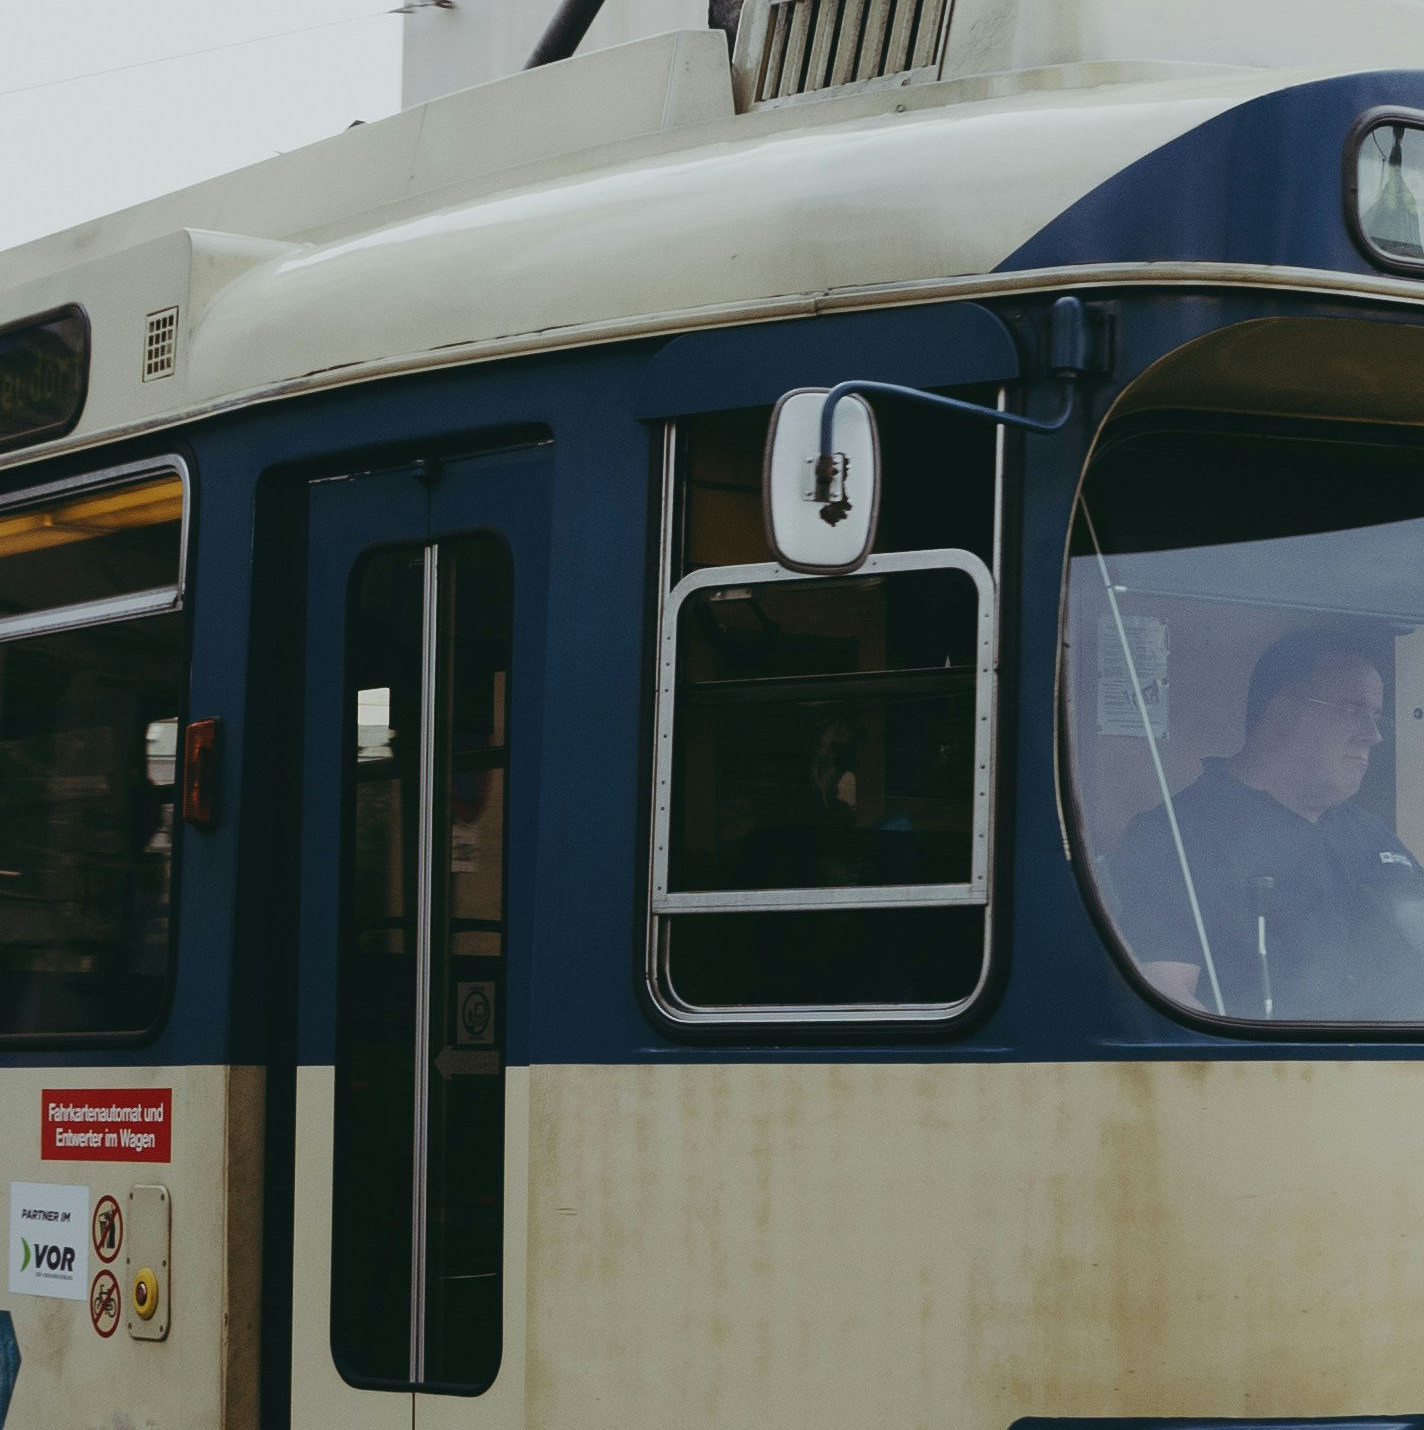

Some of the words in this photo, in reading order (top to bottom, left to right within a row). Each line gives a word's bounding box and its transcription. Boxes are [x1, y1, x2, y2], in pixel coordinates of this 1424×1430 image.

[48, 1102, 142, 1122] Fahrkartenautomat
[144, 1102, 164, 1122] und
[55, 1127, 103, 1147] Entwerter
[105, 1128, 118, 1147] im
[119, 1128, 156, 1152] Wagen
[21, 1208, 59, 1222] PARTNER
[60, 1211, 71, 1223] IM
[33, 1243, 75, 1272] VOR
